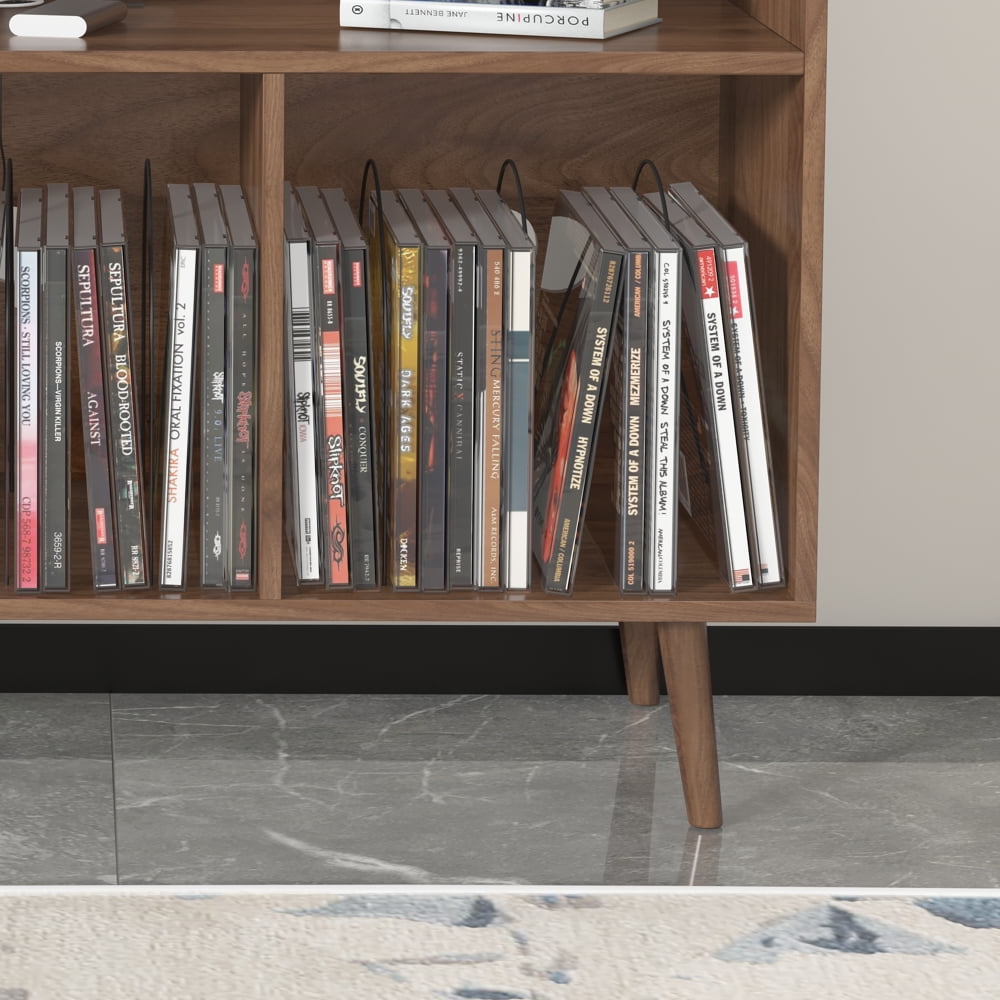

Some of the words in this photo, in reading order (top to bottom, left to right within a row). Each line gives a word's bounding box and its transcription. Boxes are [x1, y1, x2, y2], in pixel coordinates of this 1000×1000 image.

[404, 8, 444, 17] BENNETT
[496, 12, 590, 27] PORCUPINE
[21, 266, 31, 324] SCORPIONS
[108, 262, 126, 342] SEPULTURA
[174, 315, 186, 335] vol.
[401, 286, 414, 339] SOULFLY
[21, 331, 31, 361] STILL
[591, 327, 608, 366] SYSTEM
[661, 319, 671, 360] SYSTEM
[707, 312, 720, 351] SYSTEM
[731, 322, 740, 354] SYSTEM
[77, 264, 95, 347] SEPULTURA
[87, 391, 101, 447] AGAINST
[490, 329, 502, 378] STING
[712, 355, 722, 368] OF
[734, 355, 742, 366] OF
[21, 363, 31, 401] LOVING
[172, 343, 184, 401] FIXATION
[353, 355, 367, 414] SOULFLY
[456, 351, 464, 389] STATIC
[588, 369, 601, 382] OF
[629, 347, 641, 406] MEZMERIZE
[662, 363, 670, 376] OF
[714, 371, 723, 379] A
[400, 369, 412, 409] DARK
[456, 392, 464, 400] X
[660, 386, 669, 415] DOWN
[715, 382, 727, 411] DOWN
[737, 375, 746, 399] DOWN
[21, 403, 31, 427] YOU
[115, 354, 134, 456] BLOOD-ROOTED
[491, 379, 501, 431] MERCURY
[581, 393, 595, 424] DOWN
[54, 416, 62, 442] KILLER
[170, 406, 182, 441] ORAL
[400, 415, 412, 453] AGES
[629, 416, 640, 447] DOWN
[660, 422, 669, 453] STEAL
[740, 406, 751, 441] TOXICITY
[214, 436, 223, 462] LIVE
[357, 426, 368, 473] CONQUER
[491, 434, 501, 480] FALLING
[570, 436, 588, 490] HYPNOTIZE
[629, 449, 639, 457] A
[167, 447, 180, 504] SHAKIRA
[629, 460, 639, 473] OF
[659, 456, 668, 478] THIS
[22, 496, 32, 514] CDP
[628, 475, 639, 516] SYSTEM
[22, 518, 32, 545] 568-7
[559, 518, 571, 548] AMERICAN
[22, 546, 32, 575] 98732
[53, 531, 63, 569] 3659-2-R
[130, 545, 139, 555] RR
[490, 567, 498, 584] INC.
[627, 572, 635, 585] COL
